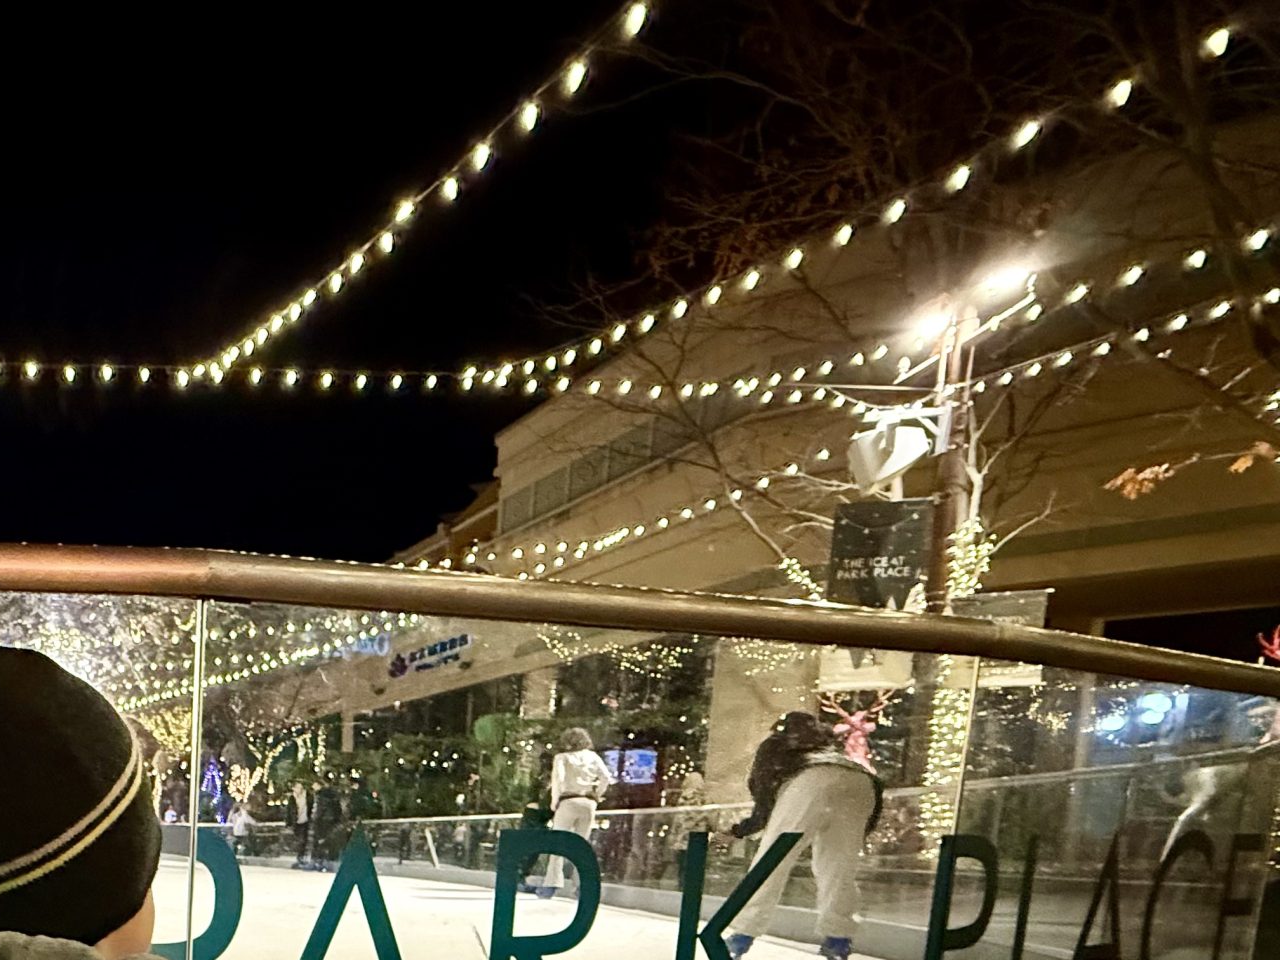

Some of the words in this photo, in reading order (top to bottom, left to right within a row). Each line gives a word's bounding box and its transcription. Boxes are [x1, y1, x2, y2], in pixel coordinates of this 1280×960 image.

[843, 558, 865, 568] THE
[869, 556, 888, 567] ICE
[890, 555, 905, 566] AT
[837, 569, 869, 579] PARK
[873, 566, 911, 577] PLACE
